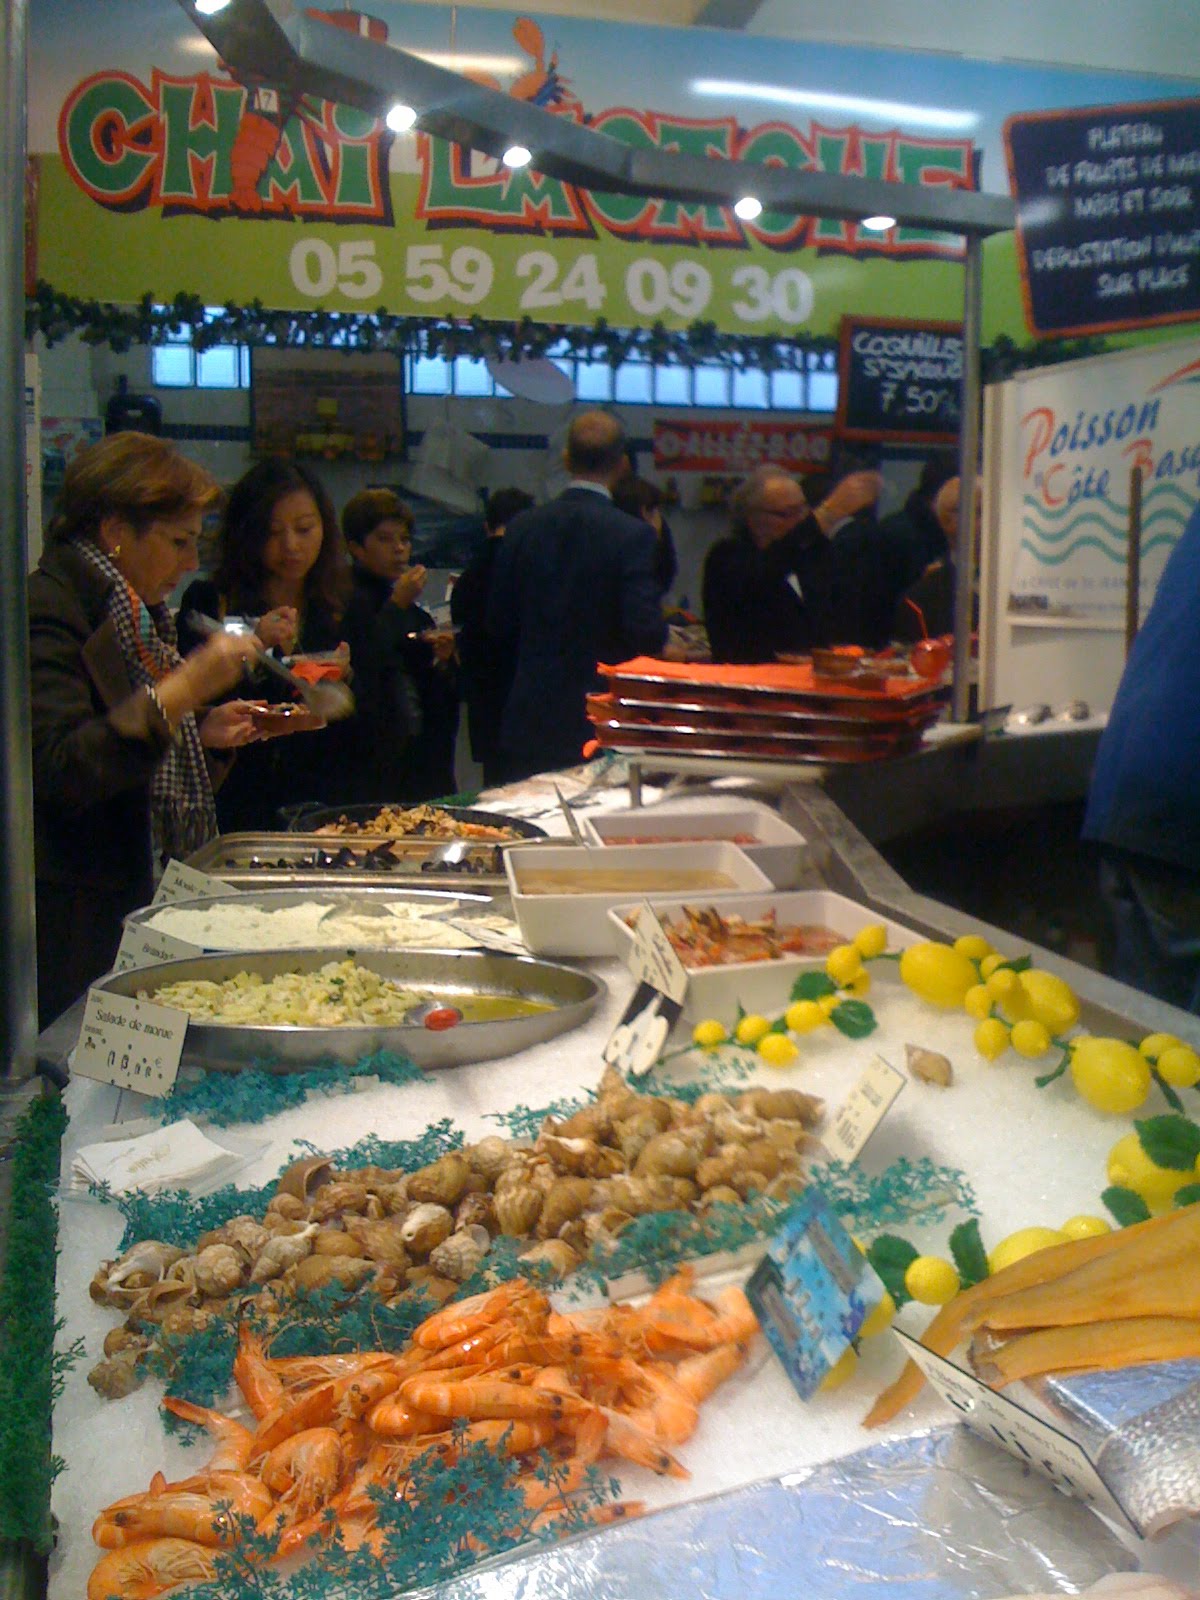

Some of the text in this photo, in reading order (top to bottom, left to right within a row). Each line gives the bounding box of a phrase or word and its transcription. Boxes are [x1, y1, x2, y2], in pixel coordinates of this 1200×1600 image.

[289, 238, 814, 324] 05 59 24 09 30
[1020, 398, 1161, 480] Poisson
[95, 1008, 127, 1030] Salade
[128, 1017, 144, 1034] de
[143, 1022, 174, 1042] morue
